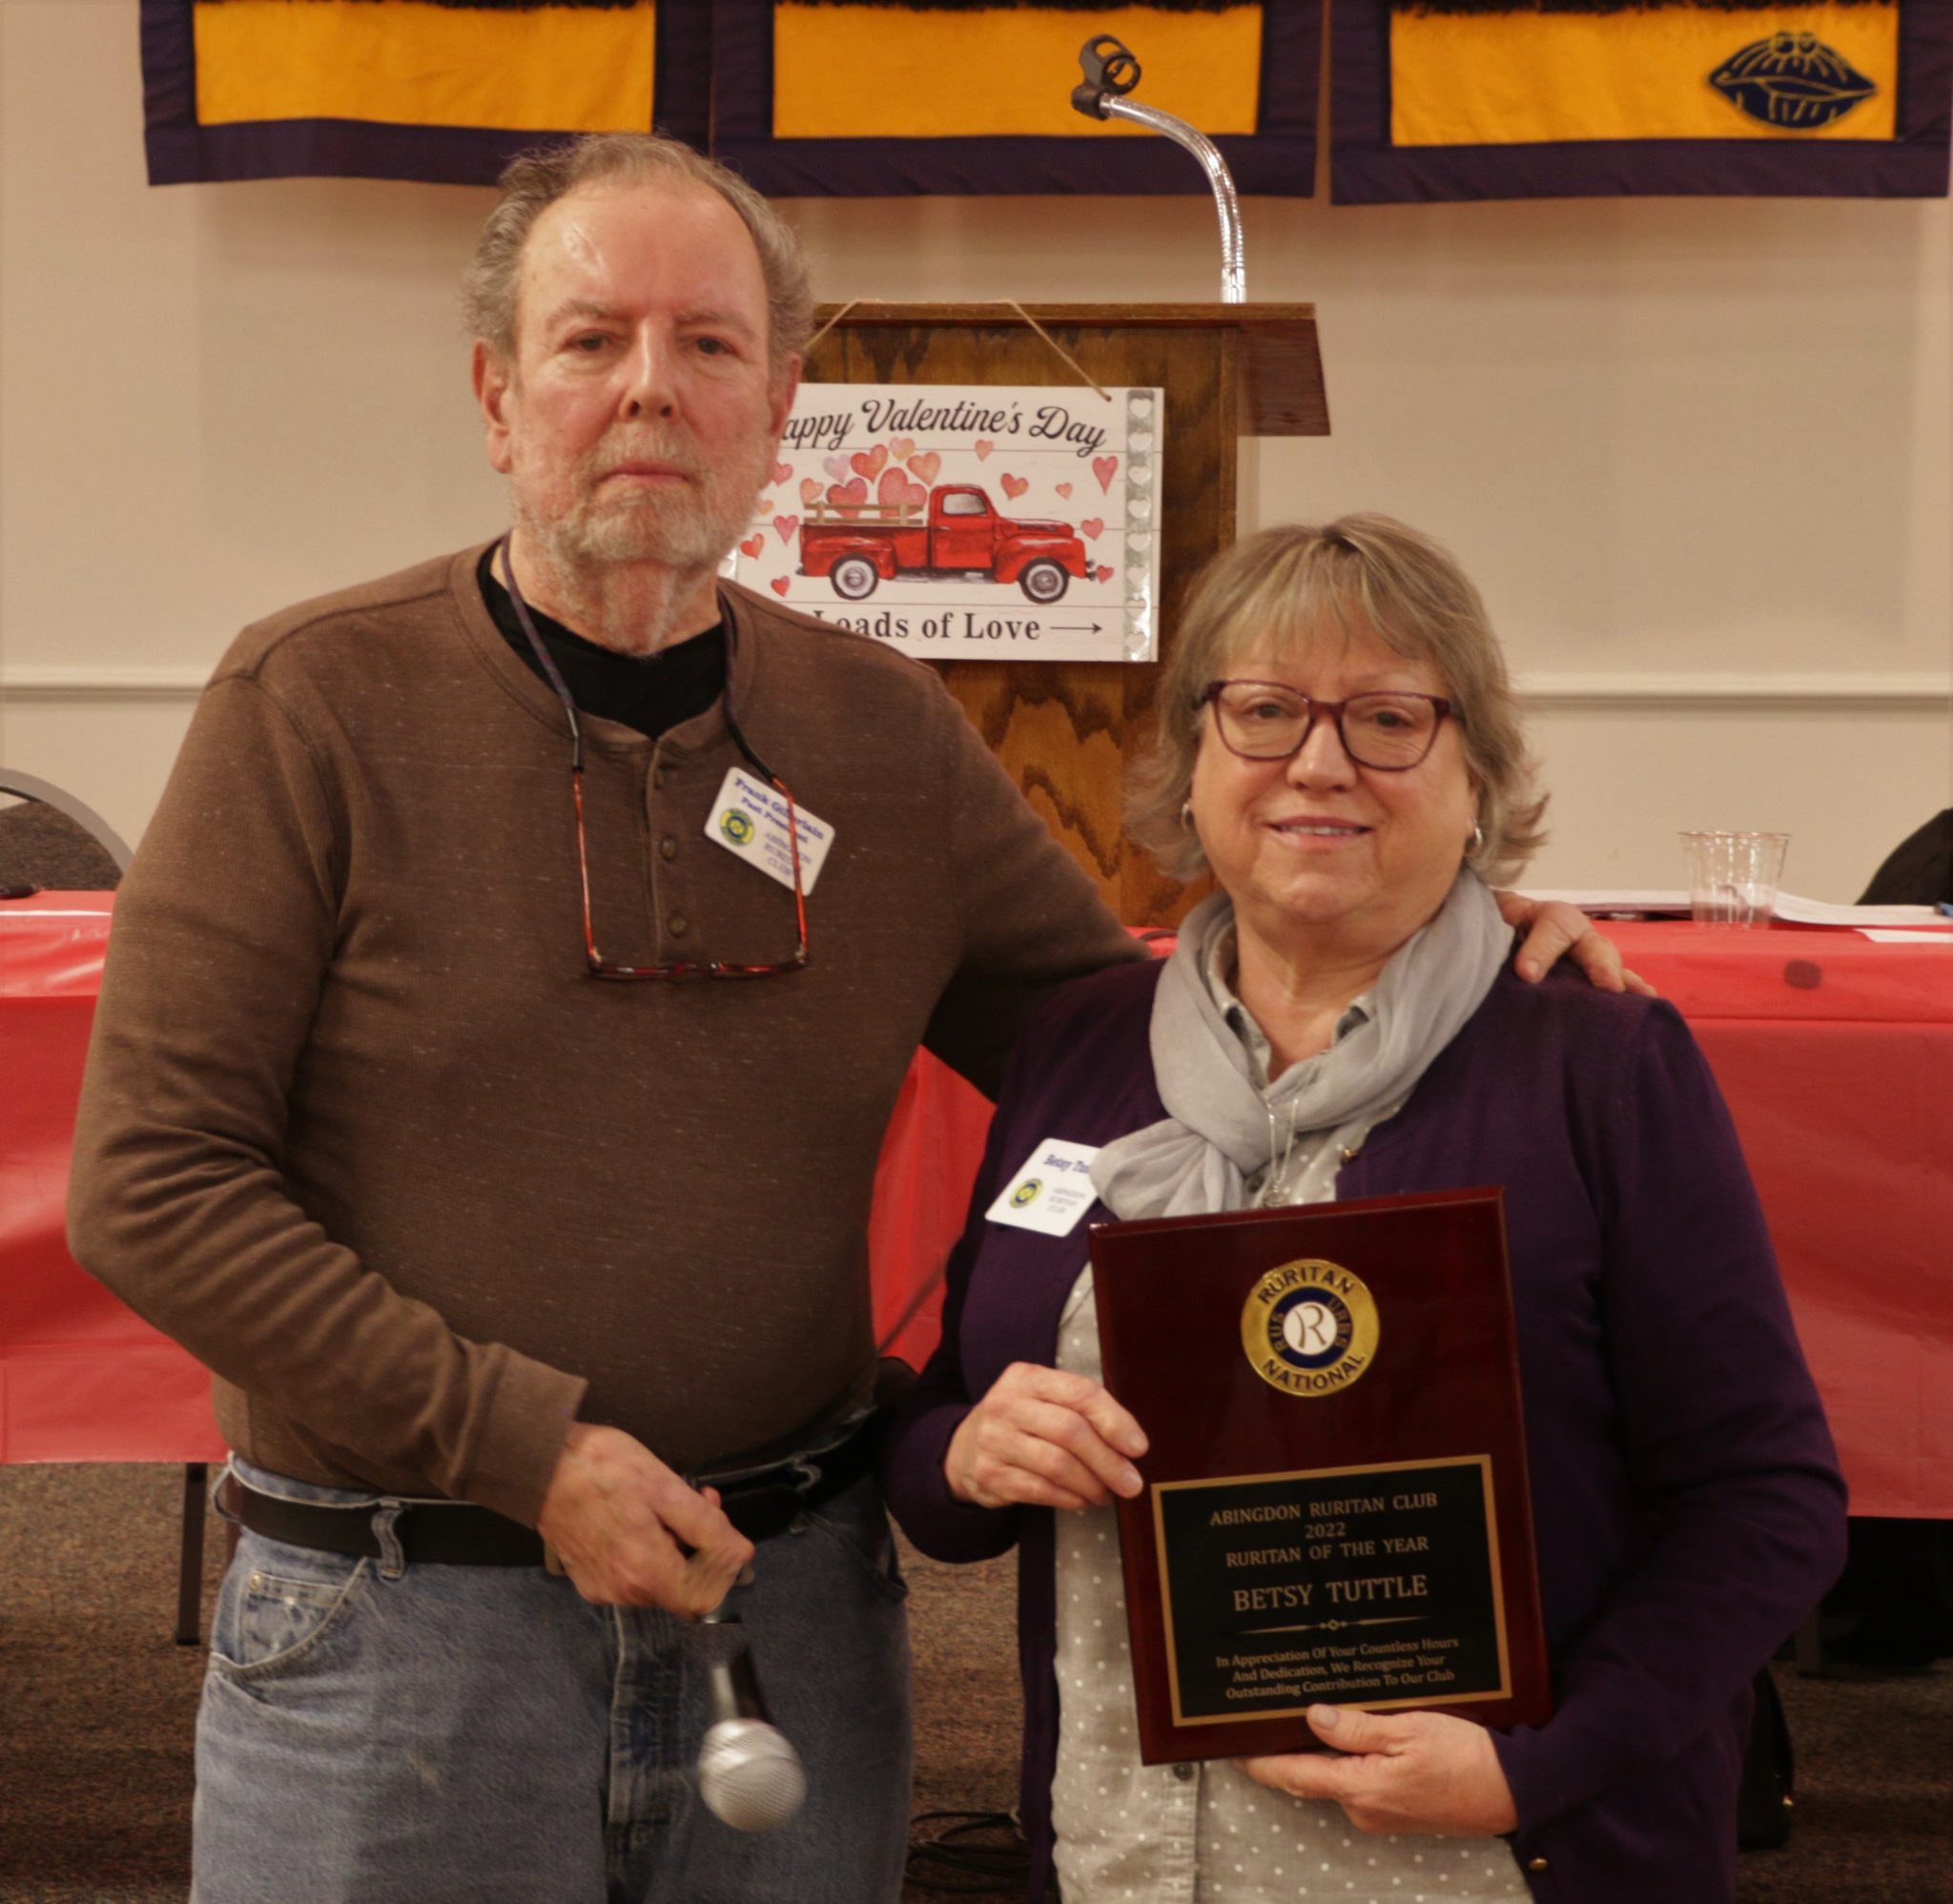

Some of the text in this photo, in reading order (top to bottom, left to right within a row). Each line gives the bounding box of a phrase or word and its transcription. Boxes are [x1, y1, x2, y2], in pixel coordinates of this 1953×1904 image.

[781, 399, 1108, 458] appy Valentine's Day
[922, 611, 955, 639] of
[964, 612, 1041, 640] Love
[735, 777, 769, 805] Frank
[1257, 1266, 1354, 1304] RURITAN
[1294, 1304, 1326, 1349] R
[1263, 1355, 1366, 1390] NATIONAL
[1210, 1492, 1438, 1525] ABINGDON RURITAN CLUB
[1305, 1522, 1347, 1540] 2022
[1226, 1536, 1429, 1568] RURITAN OF THE YEAR
[1233, 1574, 1429, 1612] BETSY TUTTLE
[1216, 1637, 1460, 1669] In Appreciation Of Your Countless Hours
[1232, 1669, 1258, 1684] And
[1330, 1661, 1350, 1675] We
[1352, 1657, 1414, 1675] Recognize
[1416, 1654, 1447, 1669] Your
[1226, 1669, 1456, 1699] Outstanding Contribution To Our Club
